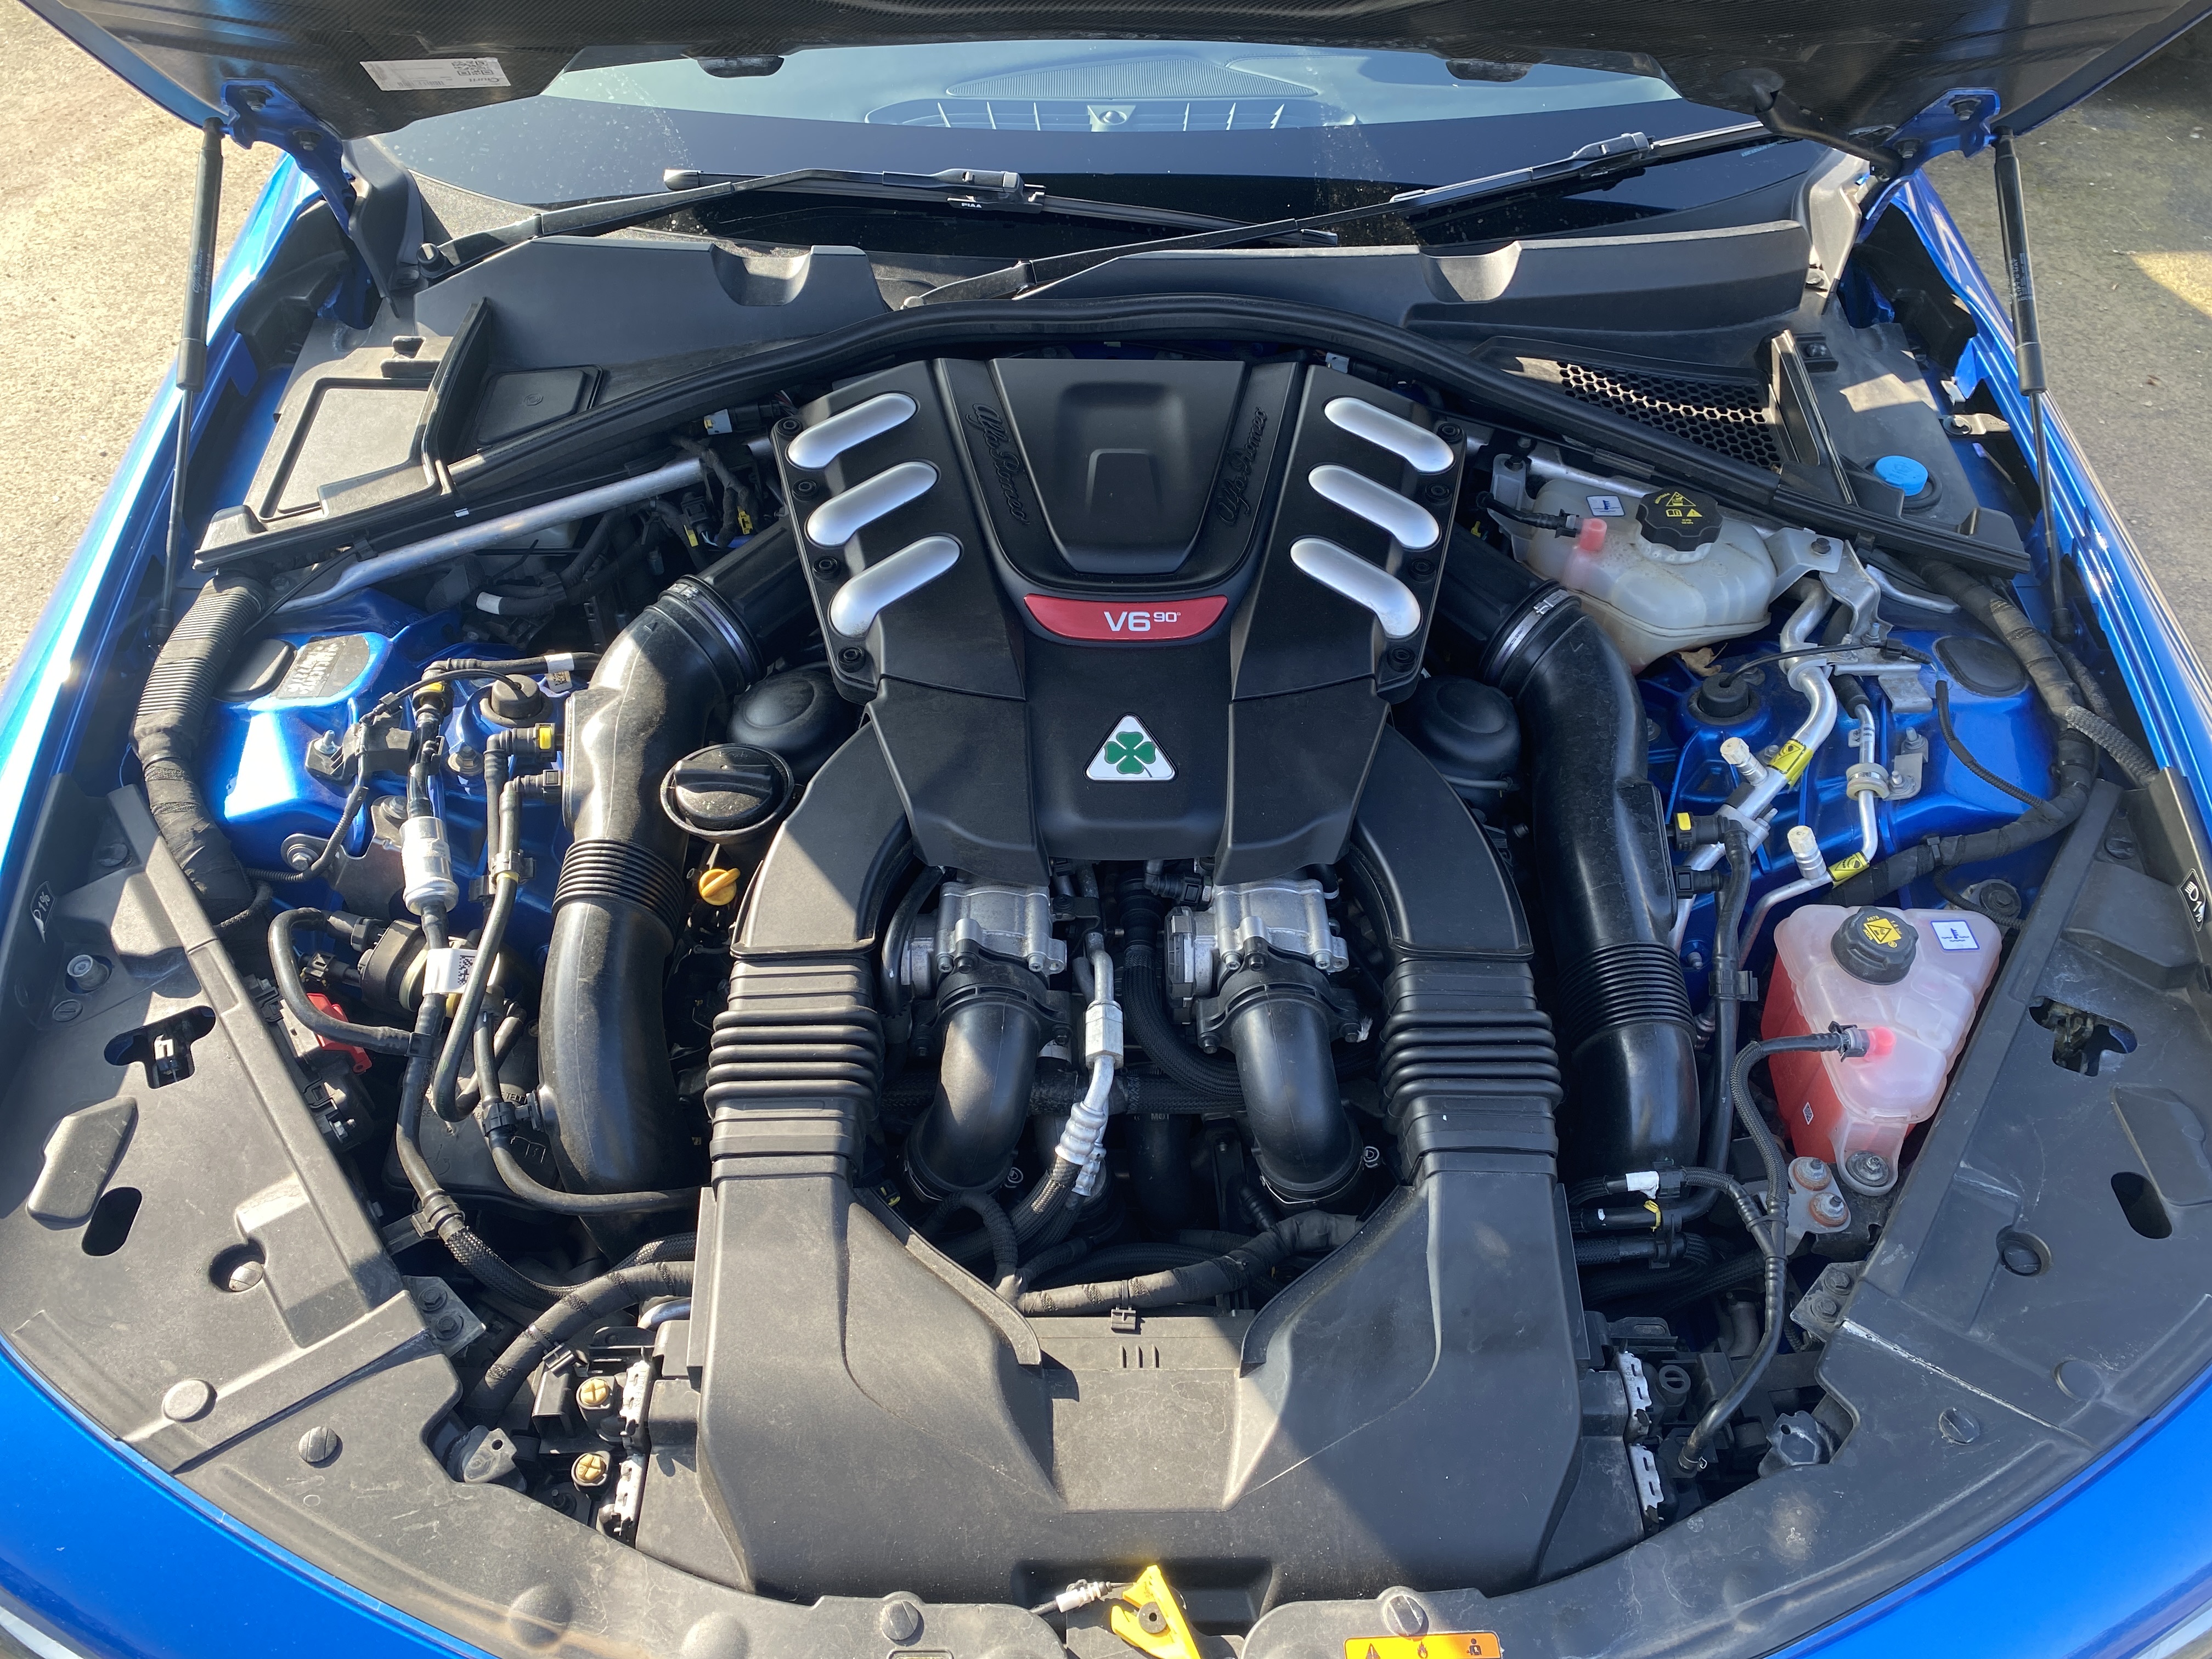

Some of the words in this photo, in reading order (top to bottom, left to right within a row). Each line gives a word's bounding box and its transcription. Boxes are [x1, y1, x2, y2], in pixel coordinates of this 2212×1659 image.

[966, 403, 1011, 452] Alfa
[990, 449, 1030, 525] Romeo
[1228, 406, 1268, 475] Romeo
[1216, 475, 1251, 526] Alfa
